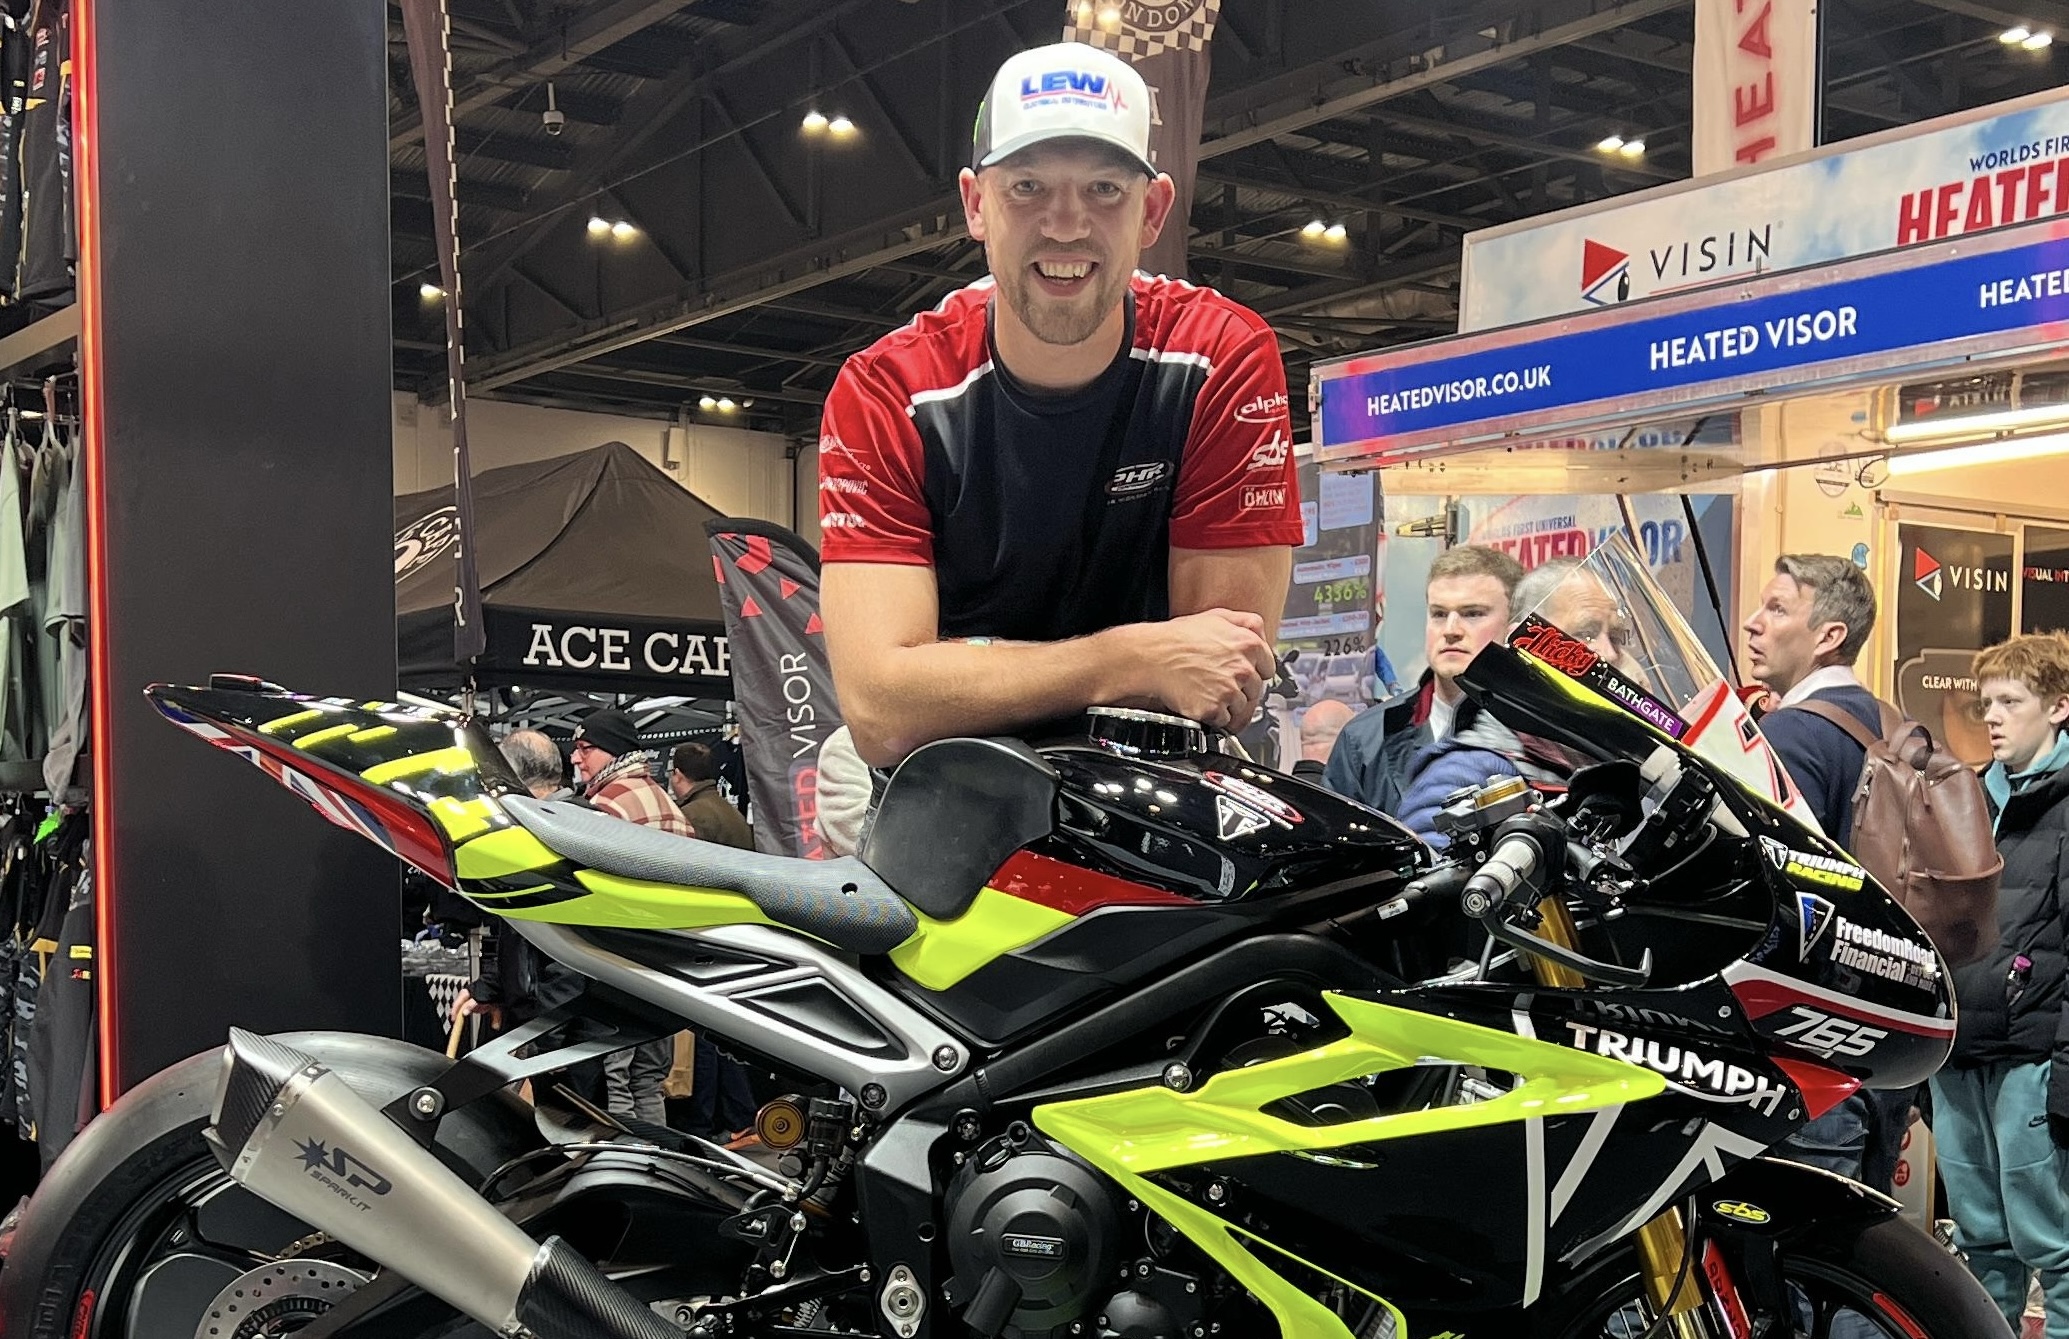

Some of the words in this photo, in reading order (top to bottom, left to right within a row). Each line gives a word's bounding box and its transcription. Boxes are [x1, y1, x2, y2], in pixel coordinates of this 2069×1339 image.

[1021, 71, 1106, 96] LEW
[1736, 0, 1775, 163] HEA
[1970, 141, 2040, 173] WORLDS
[1650, 224, 1771, 281] VISIN
[1650, 324, 1759, 372] HEATED
[1765, 306, 1857, 349] VISOR
[1367, 364, 1551, 417] HEATEDVISOR.CO.UK
[1949, 565, 2008, 592] VISIN
[523, 624, 631, 671] ACE
[780, 651, 818, 759] VISOR
[1607, 677, 1675, 732] BATHGATE
[1922, 675, 1952, 691] CLEAR
[1953, 678, 1978, 692] WITH
[1786, 862, 1863, 892] RACING
[1788, 850, 1866, 880] TRIUMPH
[1830, 939, 1907, 983] Financial
[1774, 1006, 1888, 1059] 765
[1566, 1021, 1787, 1118] TRIUMPH
[1716, 1203, 1766, 1221] sbs
